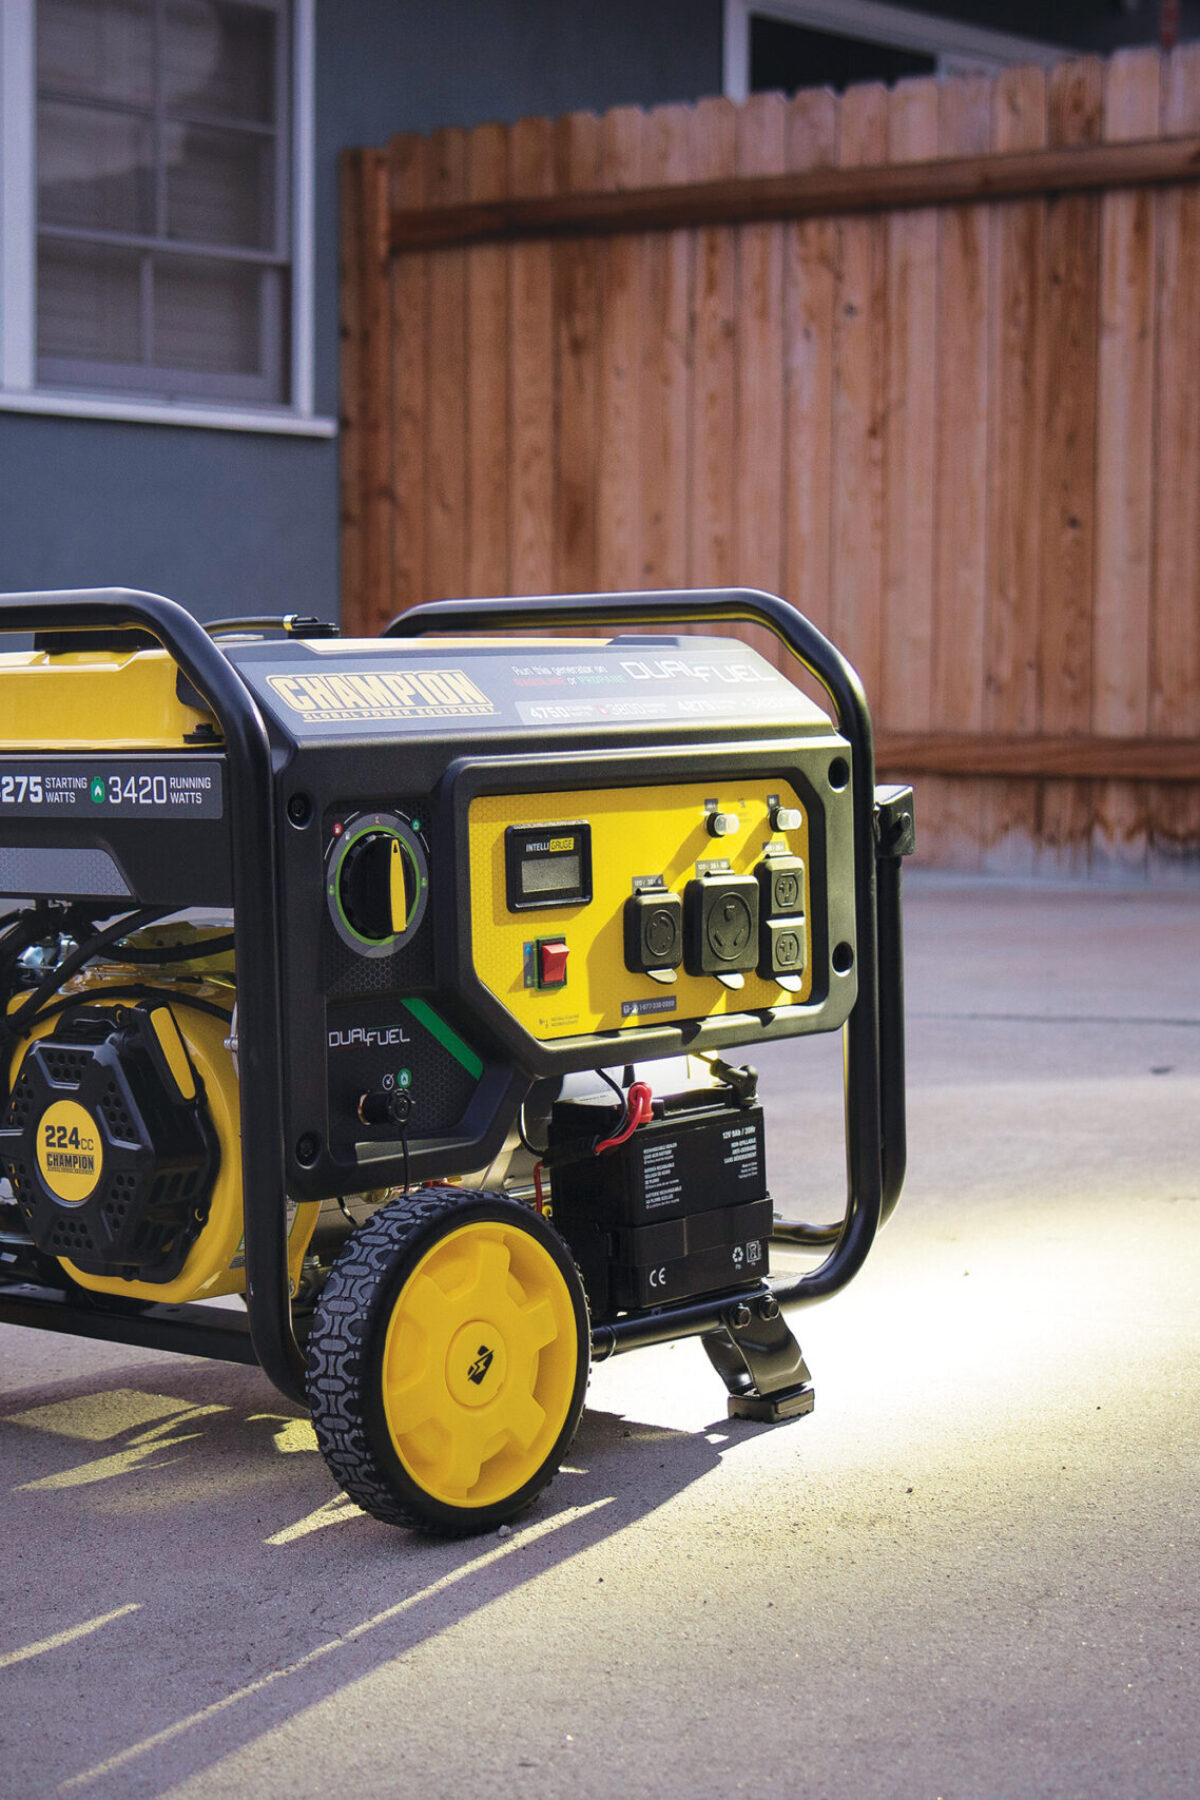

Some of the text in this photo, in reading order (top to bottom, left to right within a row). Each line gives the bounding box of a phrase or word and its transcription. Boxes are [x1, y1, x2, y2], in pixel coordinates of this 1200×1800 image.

[268, 671, 489, 711] CHAMPION
[303, 706, 494, 721] GLOBAL POWER EQUIPMENT
[0, 776, 43, 803] 275
[45, 777, 88, 789] STARTING
[108, 776, 167, 804] 3420
[169, 777, 211, 789] RUNNING
[45, 791, 76, 804] WATTS
[170, 792, 202, 804] WATTS
[47, 1153, 94, 1170] CHAMPION
[649, 1267, 666, 1287] CE
